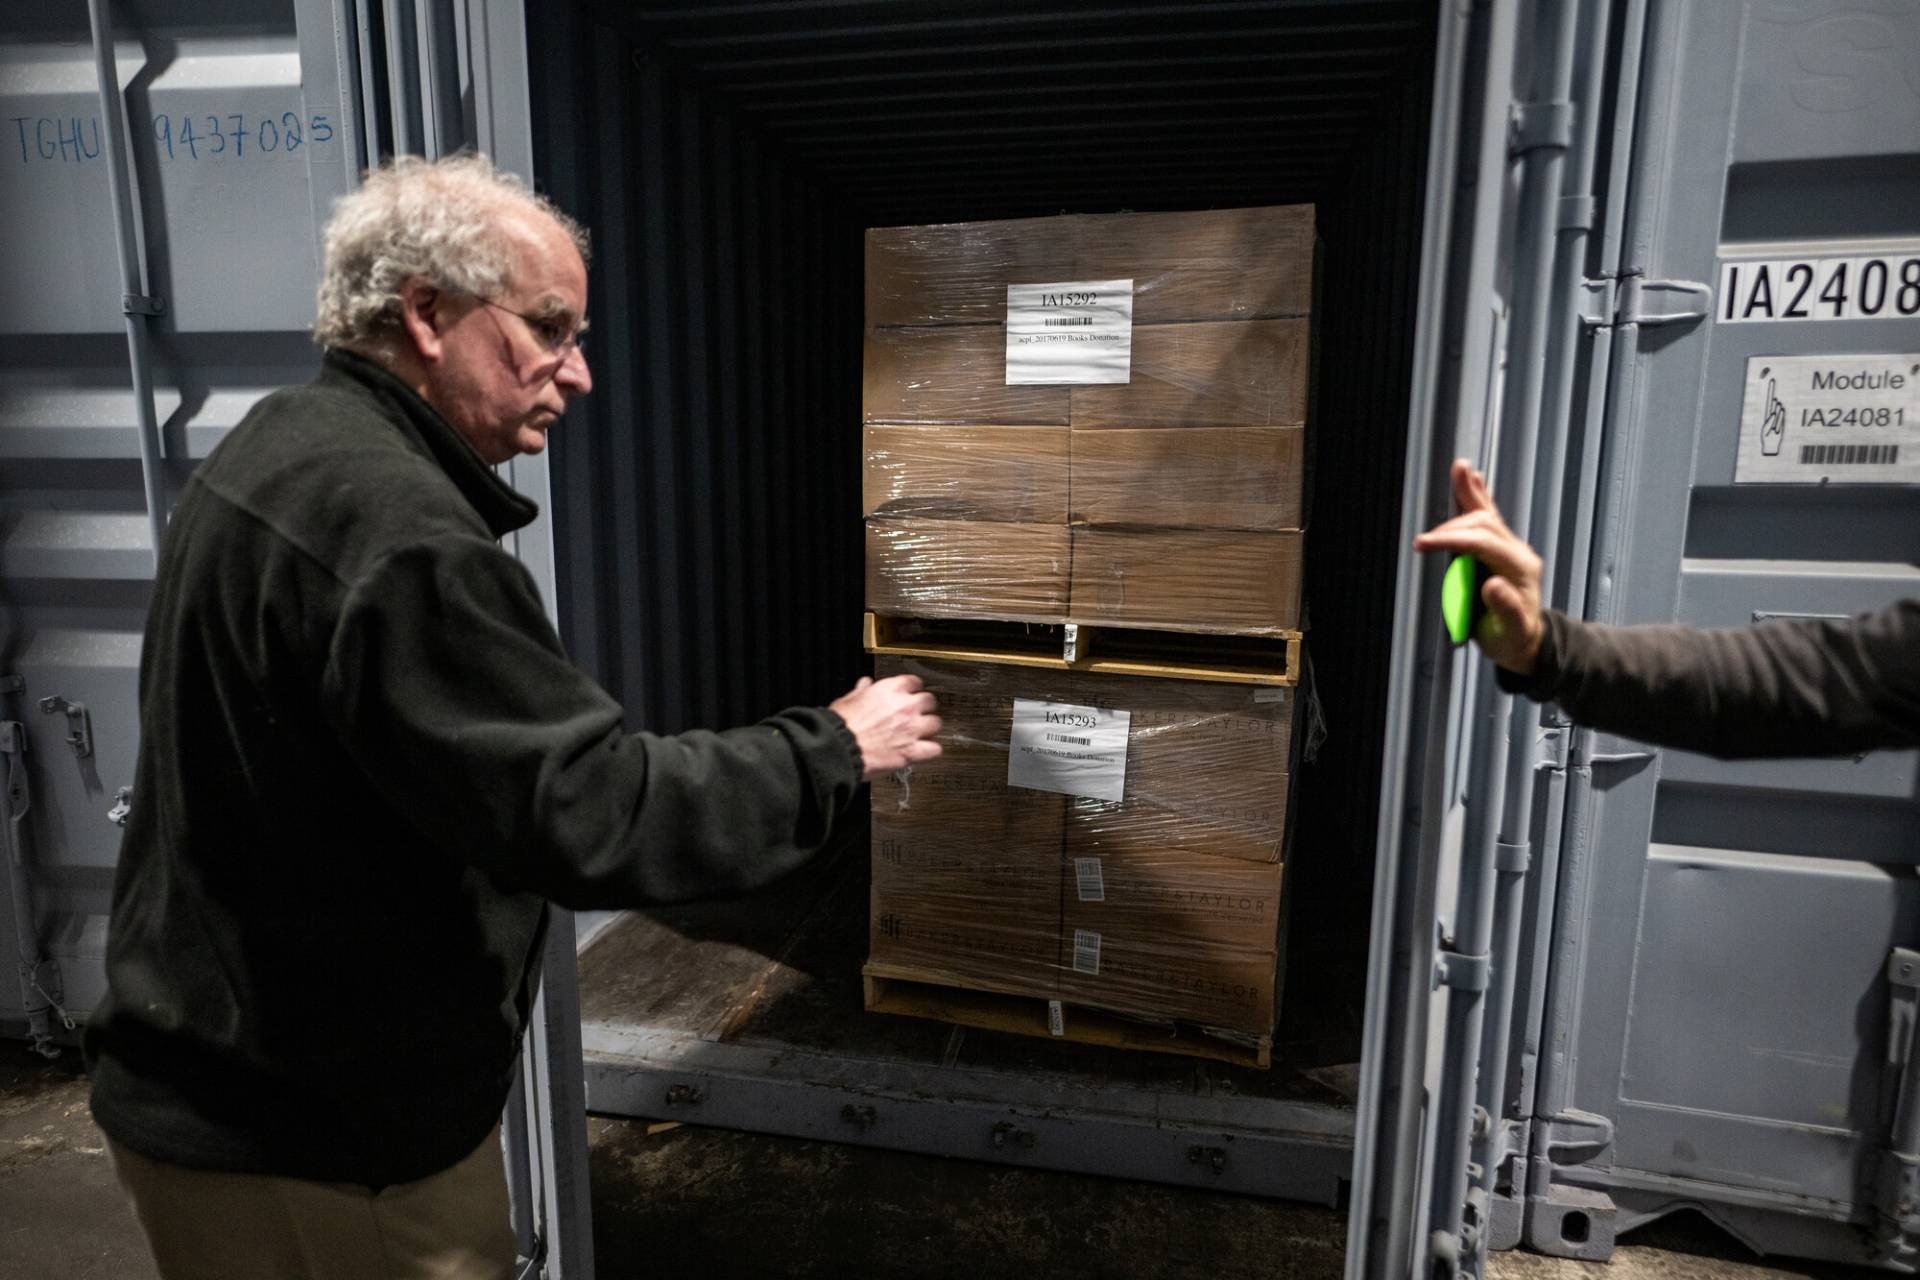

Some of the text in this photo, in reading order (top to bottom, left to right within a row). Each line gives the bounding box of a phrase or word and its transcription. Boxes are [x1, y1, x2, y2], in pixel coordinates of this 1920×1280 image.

[9, 112, 334, 163] TGHU 9437025
[1724, 259, 1920, 320] IA2408
[1041, 292, 1097, 307] IA15292
[1811, 370, 1905, 390] Module
[1801, 408, 1904, 427] IA24081
[1045, 711, 1097, 728] IA15293
